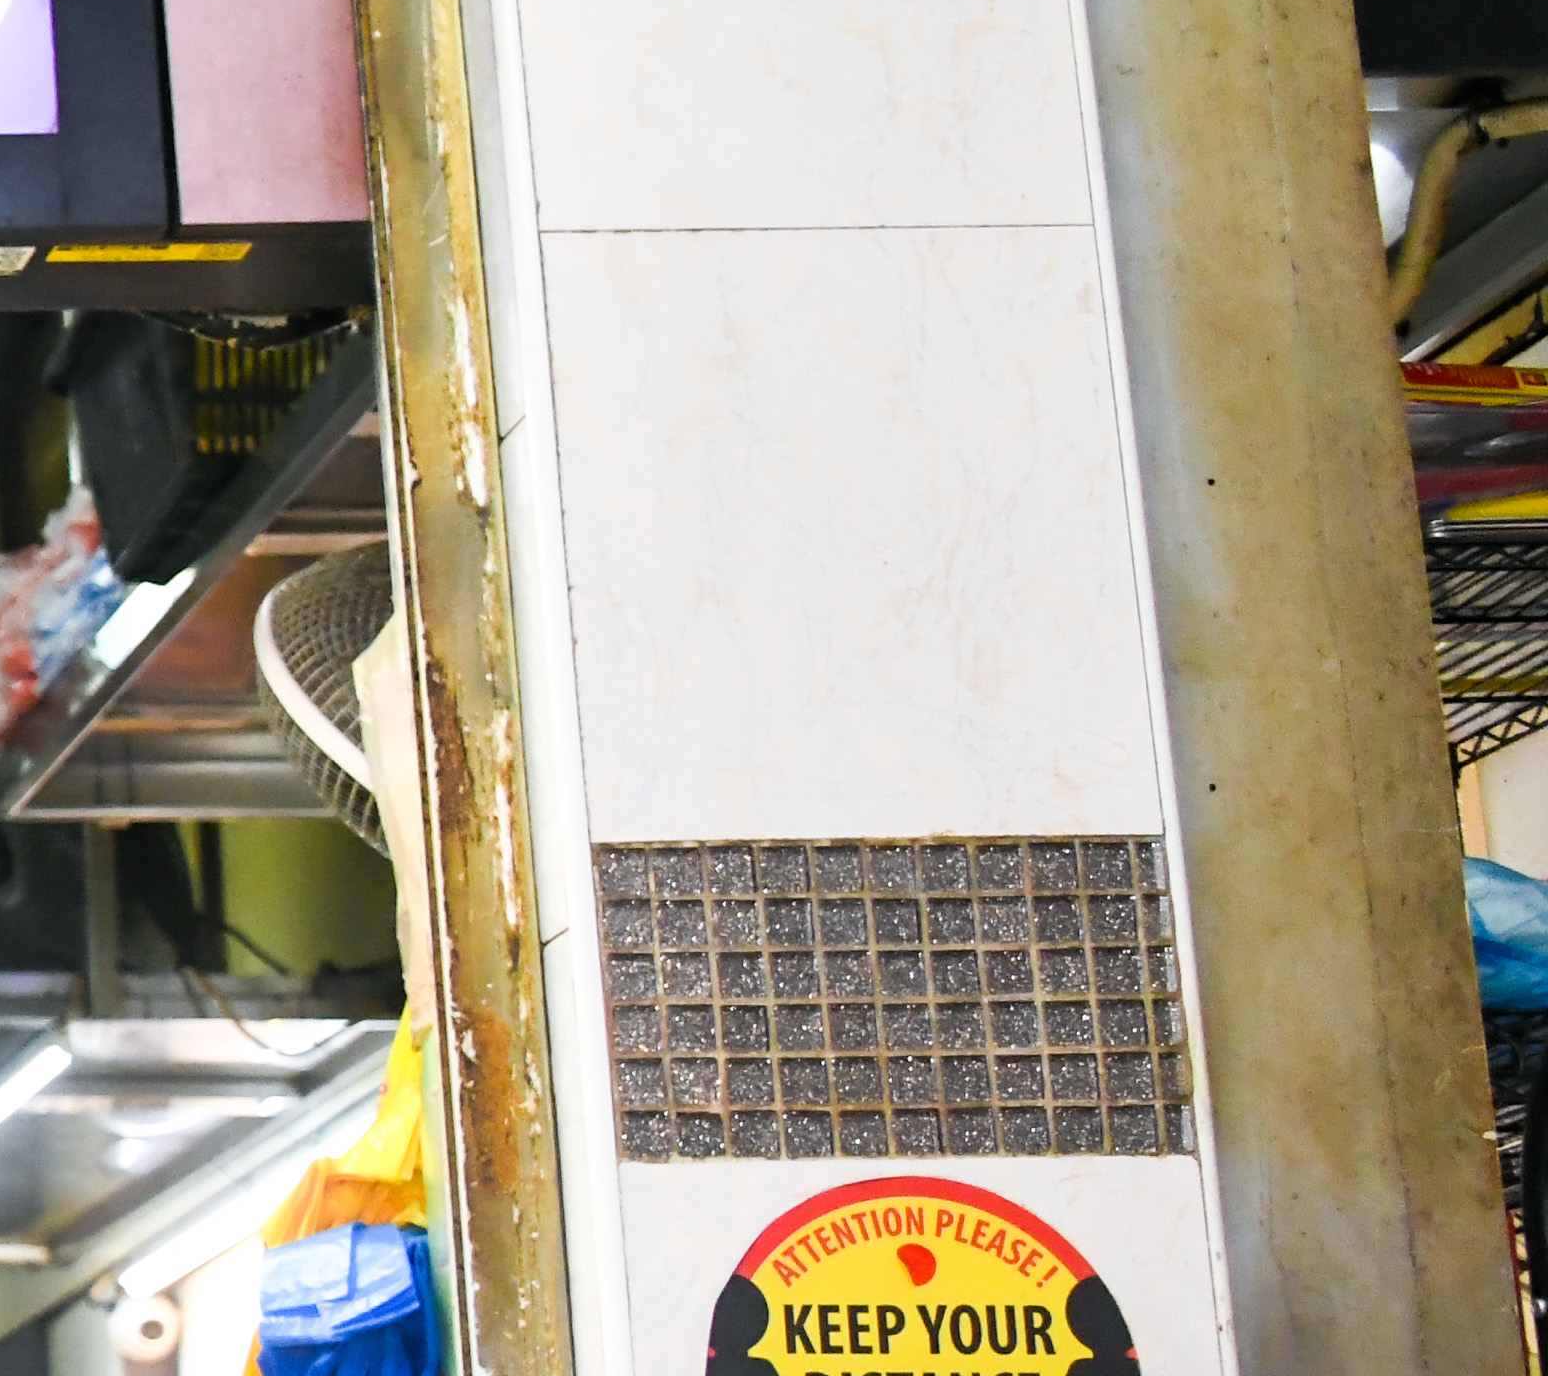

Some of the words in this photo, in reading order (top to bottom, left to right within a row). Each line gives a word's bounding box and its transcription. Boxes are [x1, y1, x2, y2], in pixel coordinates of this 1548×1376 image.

[771, 1206, 926, 1288] ATTENTION
[935, 1209, 1043, 1278] PLEASE
[783, 1304, 905, 1355] KEEP
[917, 1304, 1056, 1355] YOUR
